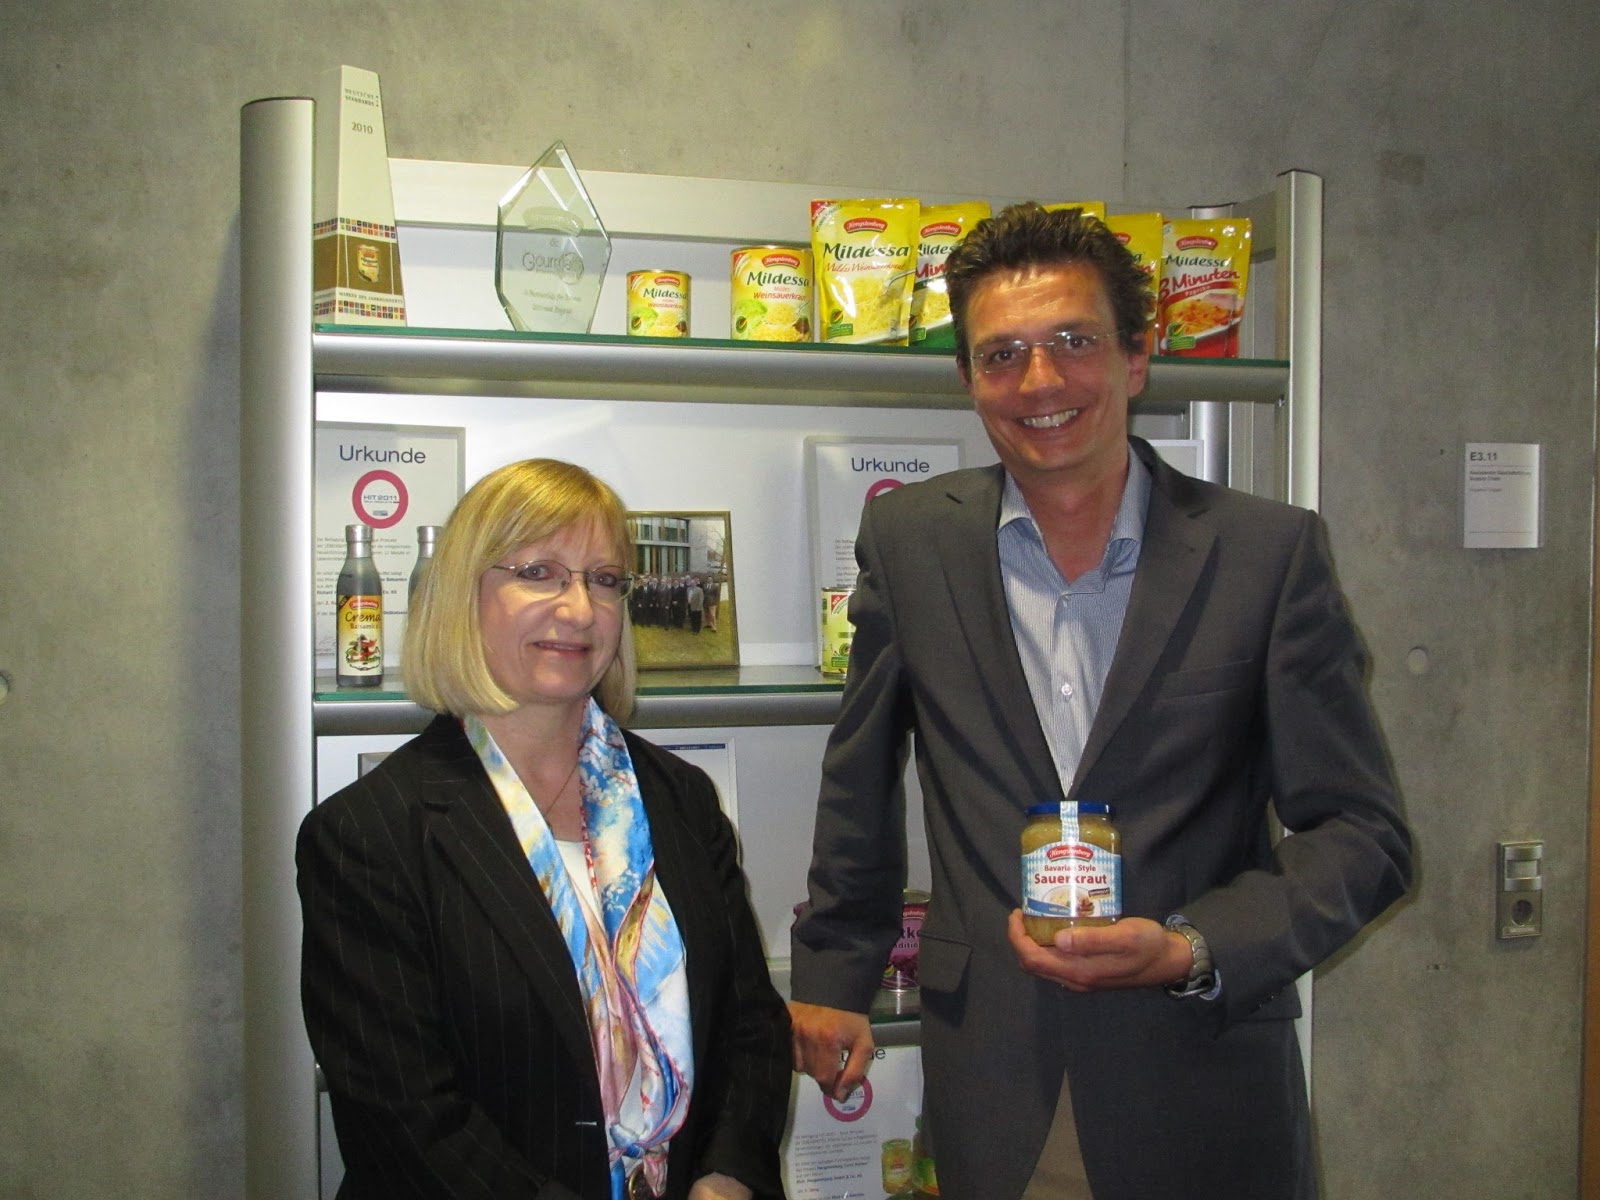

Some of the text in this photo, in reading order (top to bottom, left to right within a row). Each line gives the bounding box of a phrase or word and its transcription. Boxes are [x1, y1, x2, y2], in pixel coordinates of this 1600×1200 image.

[351, 121, 374, 134] 2010
[823, 243, 909, 261] Mildessa
[1165, 254, 1231, 268] Mildessa
[747, 271, 810, 287] Mildessa
[1172, 268, 1241, 292] Minuten
[643, 287, 687, 300] Mildessa
[339, 444, 427, 464] Urkunde
[1470, 451, 1498, 461] E3.11
[851, 457, 930, 473] Urkunde
[345, 611, 381, 622] Crema
[1044, 864, 1096, 873] Bavaria Style
[1034, 873, 1108, 885] Sauerkraut
